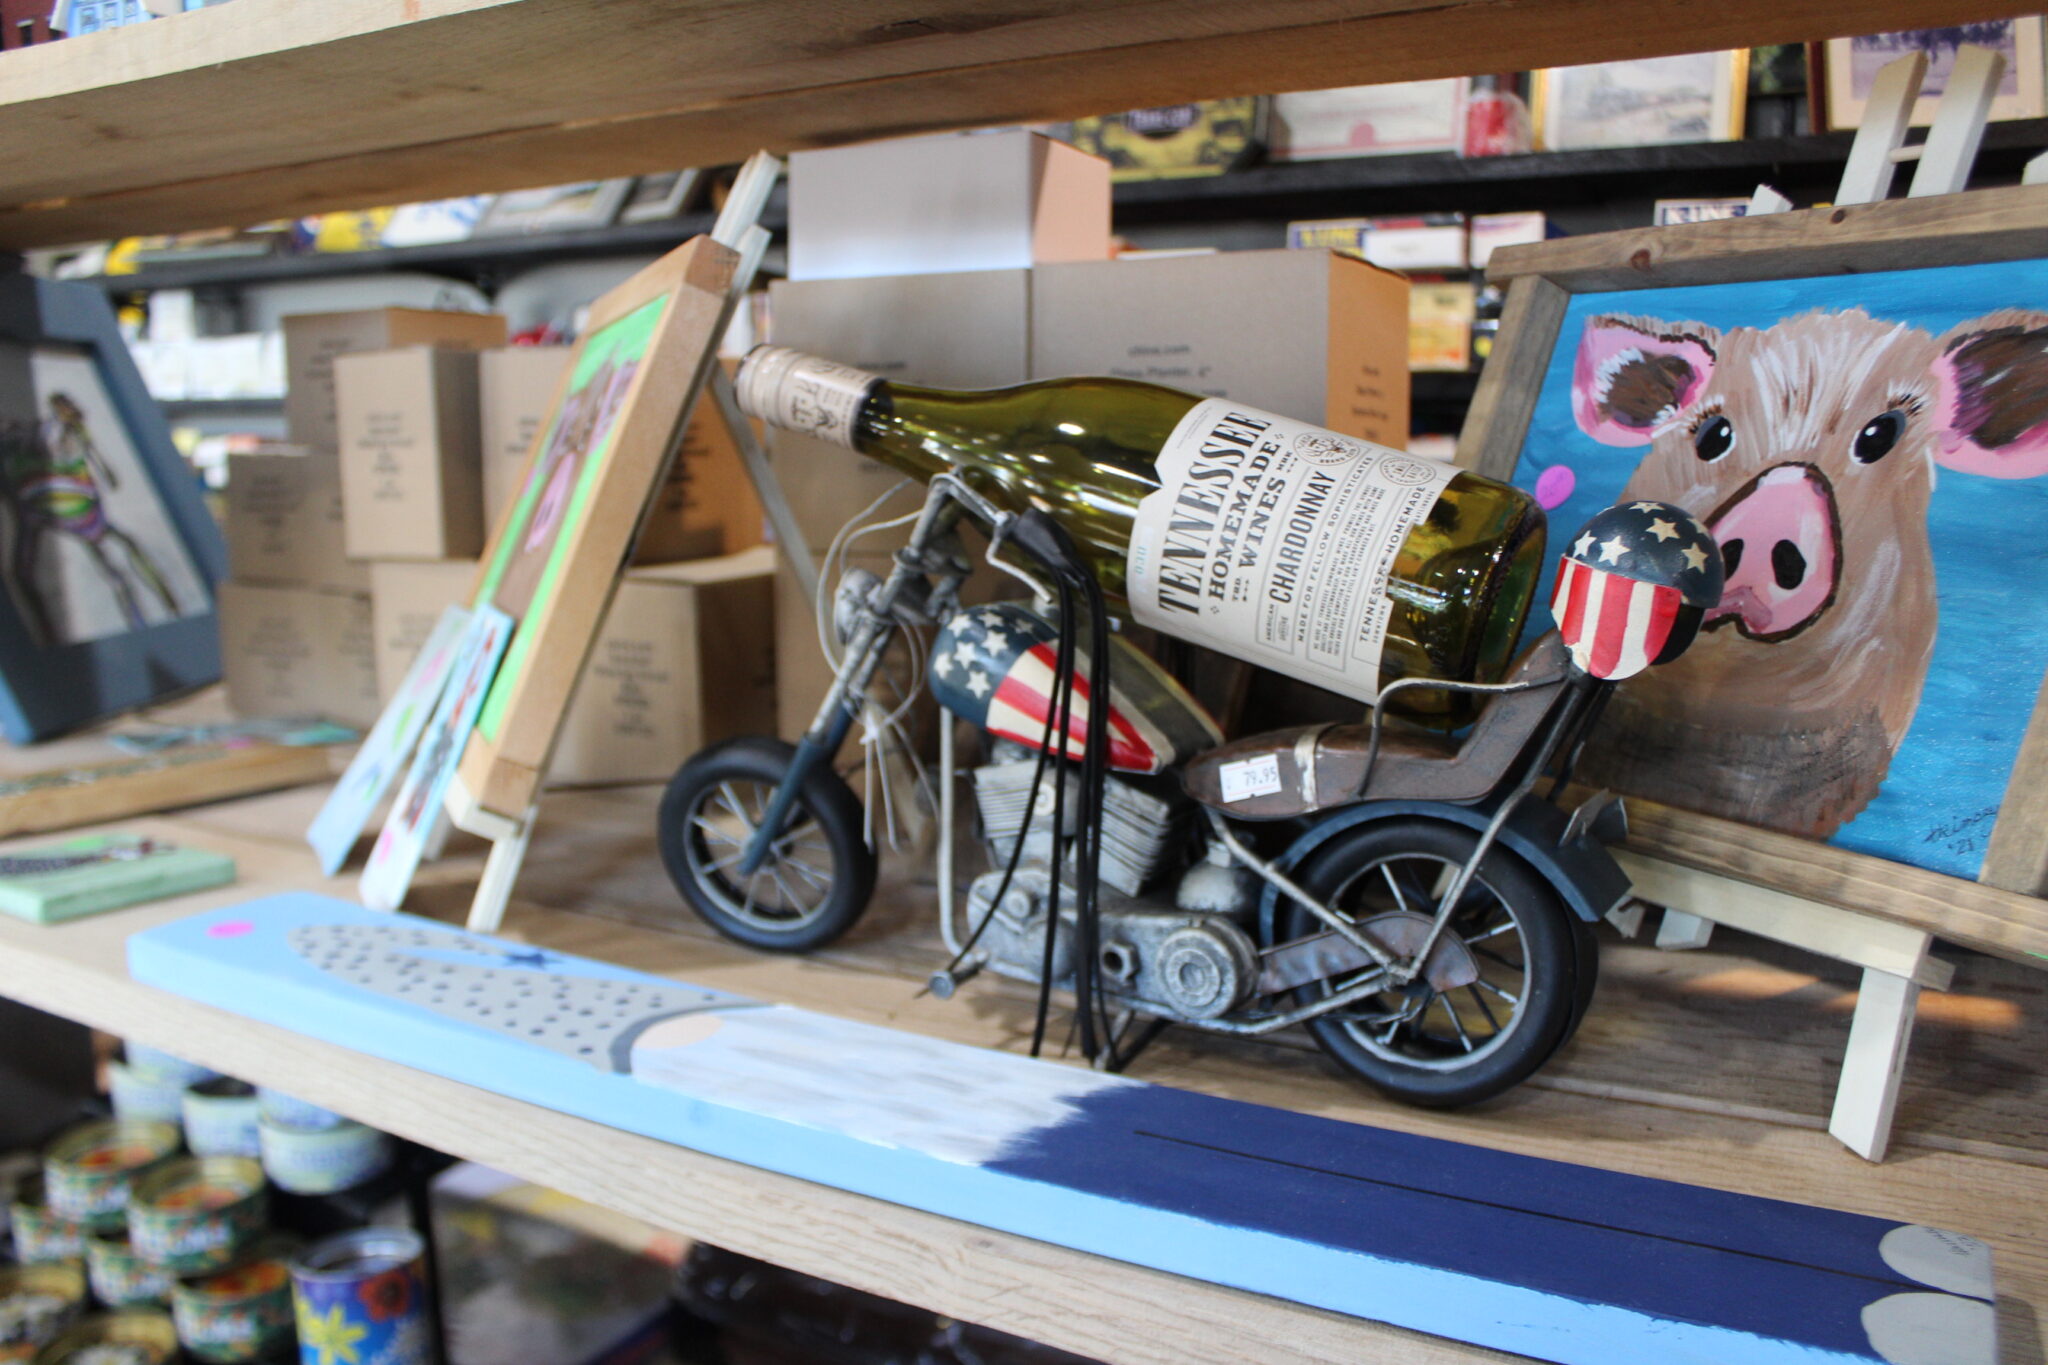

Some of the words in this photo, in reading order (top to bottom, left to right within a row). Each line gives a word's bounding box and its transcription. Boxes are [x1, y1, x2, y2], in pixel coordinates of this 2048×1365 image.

[1156, 409, 1271, 614] TENNESSEE
[1207, 439, 1281, 601] HOMEMADE
[1238, 476, 1286, 568] WINES
[1327, 456, 1373, 527] SOPHISTICATES
[1386, 484, 1426, 553] HOMEMADE
[1269, 470, 1337, 604] CHARDONNAY
[1308, 530, 1332, 580] FELLOW
[1264, 603, 1276, 640] AMERICAN
[1296, 612, 1309, 641] MADE
[1301, 584, 1314, 608] FOR
[1242, 766, 1278, 786] 79.95
